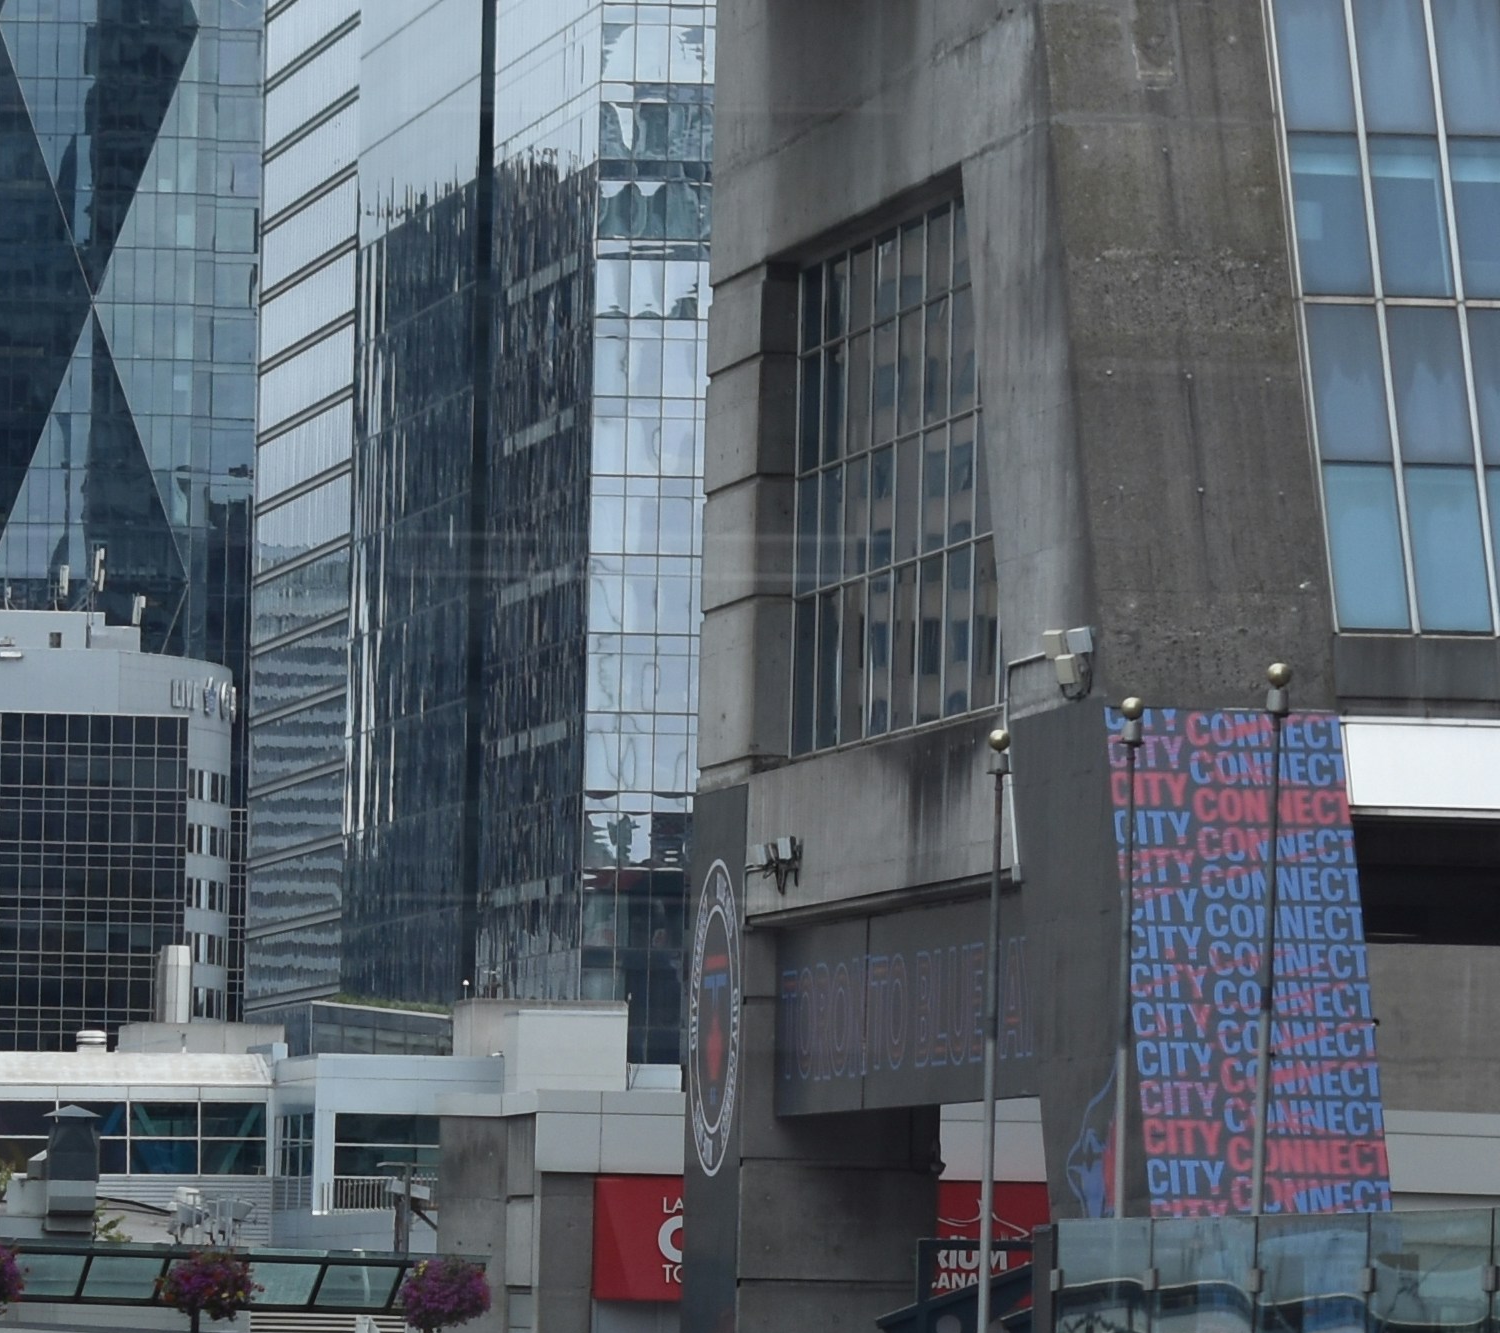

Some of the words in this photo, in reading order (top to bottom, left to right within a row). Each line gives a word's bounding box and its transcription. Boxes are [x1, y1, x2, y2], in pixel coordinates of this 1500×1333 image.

[1131, 964, 1206, 998] CITY
[781, 953, 908, 1082] TORONTO
[915, 942, 985, 1069] BLUE
[1132, 1002, 1210, 1038] CITY
[1137, 1041, 1212, 1077] CITY
[1140, 1081, 1218, 1116] CITY
[1143, 1120, 1221, 1155] CITY
[1147, 1159, 1224, 1195] CITY
